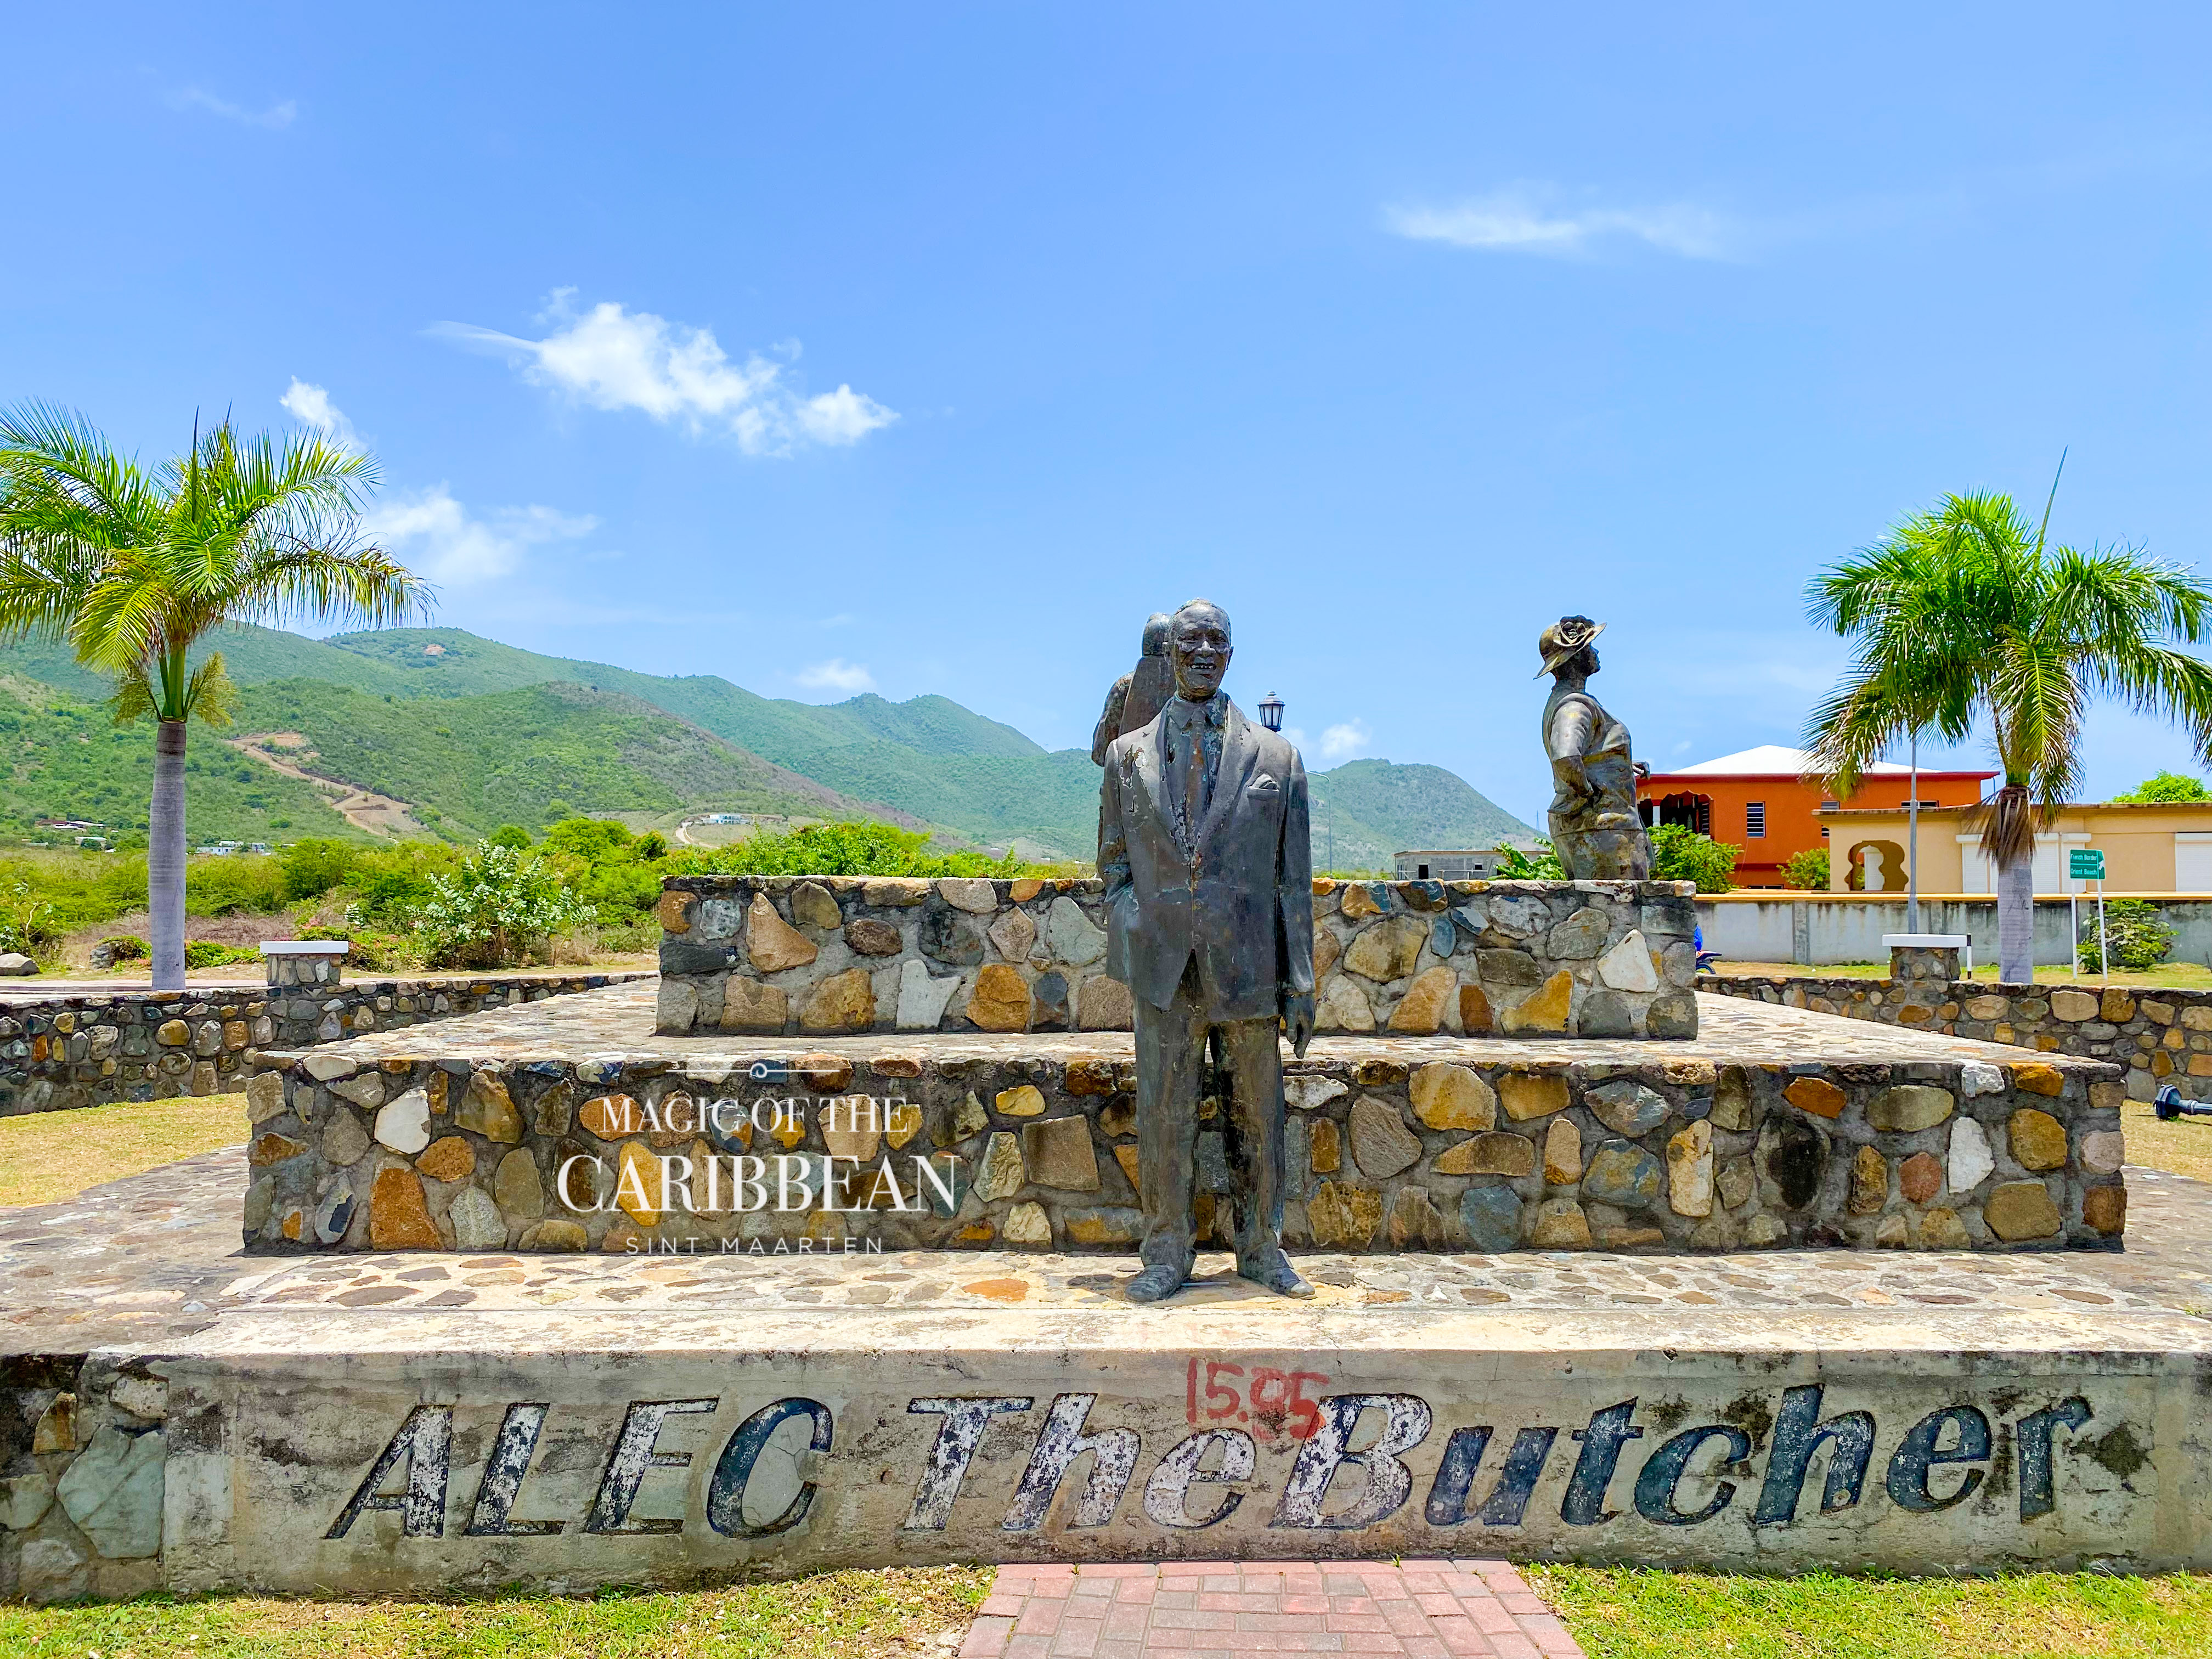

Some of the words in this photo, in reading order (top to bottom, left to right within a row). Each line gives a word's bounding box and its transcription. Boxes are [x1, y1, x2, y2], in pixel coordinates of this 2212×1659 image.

[326, 1397, 833, 1539] ALEC
[904, 1392, 1257, 1531] The
[1269, 1383, 2092, 1528] Butcher
